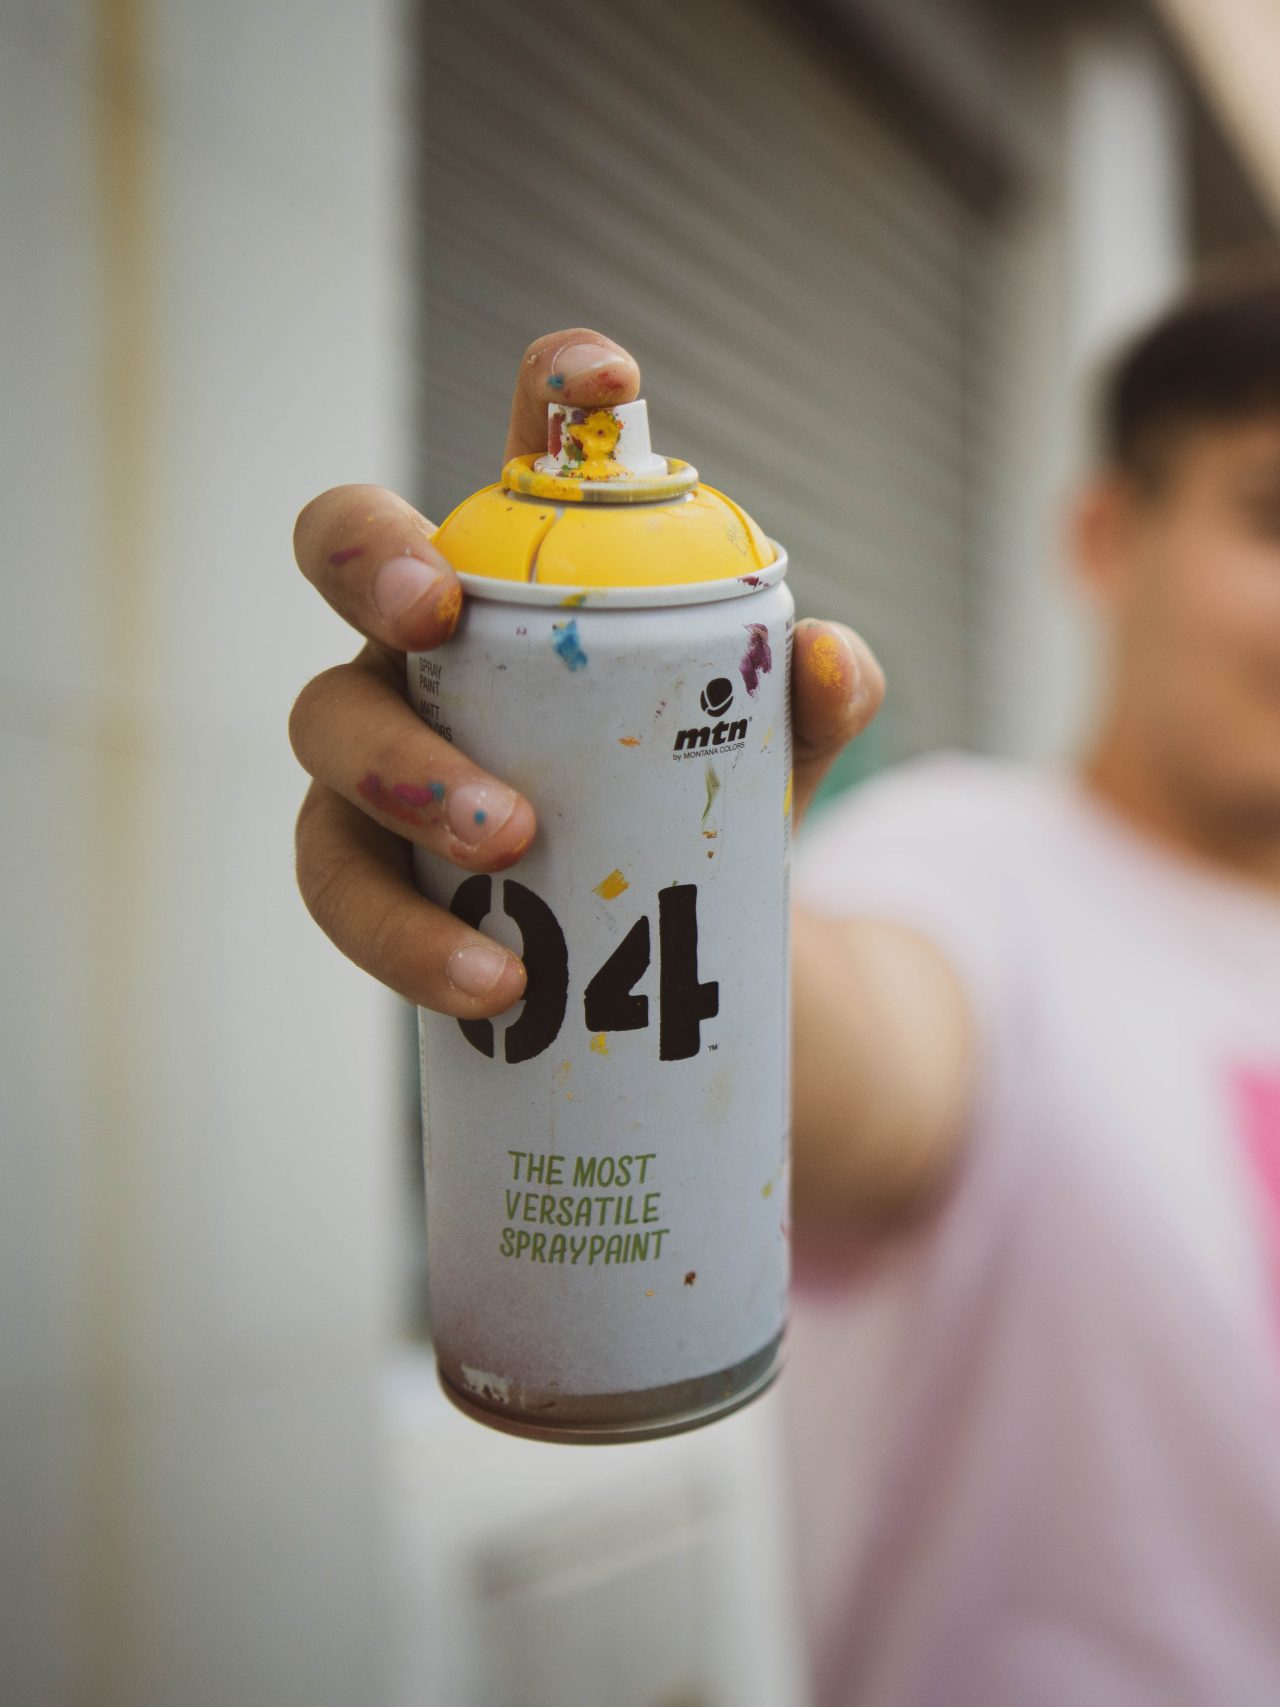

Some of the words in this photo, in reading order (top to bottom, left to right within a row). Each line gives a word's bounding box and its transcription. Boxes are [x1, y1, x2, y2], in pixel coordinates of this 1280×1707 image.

[419, 658, 442, 679] SPRAY
[419, 674, 440, 696] PAINT
[420, 698, 440, 721] MATT
[683, 748, 718, 760] MONTANA
[719, 742, 745, 753] COLORS
[449, 874, 719, 1064] 04
[508, 1150, 565, 1185] THE
[572, 1152, 657, 1188] MOST
[505, 1189, 661, 1227] VERSATILE
[499, 1228, 670, 1265] SPRAYPAINT
